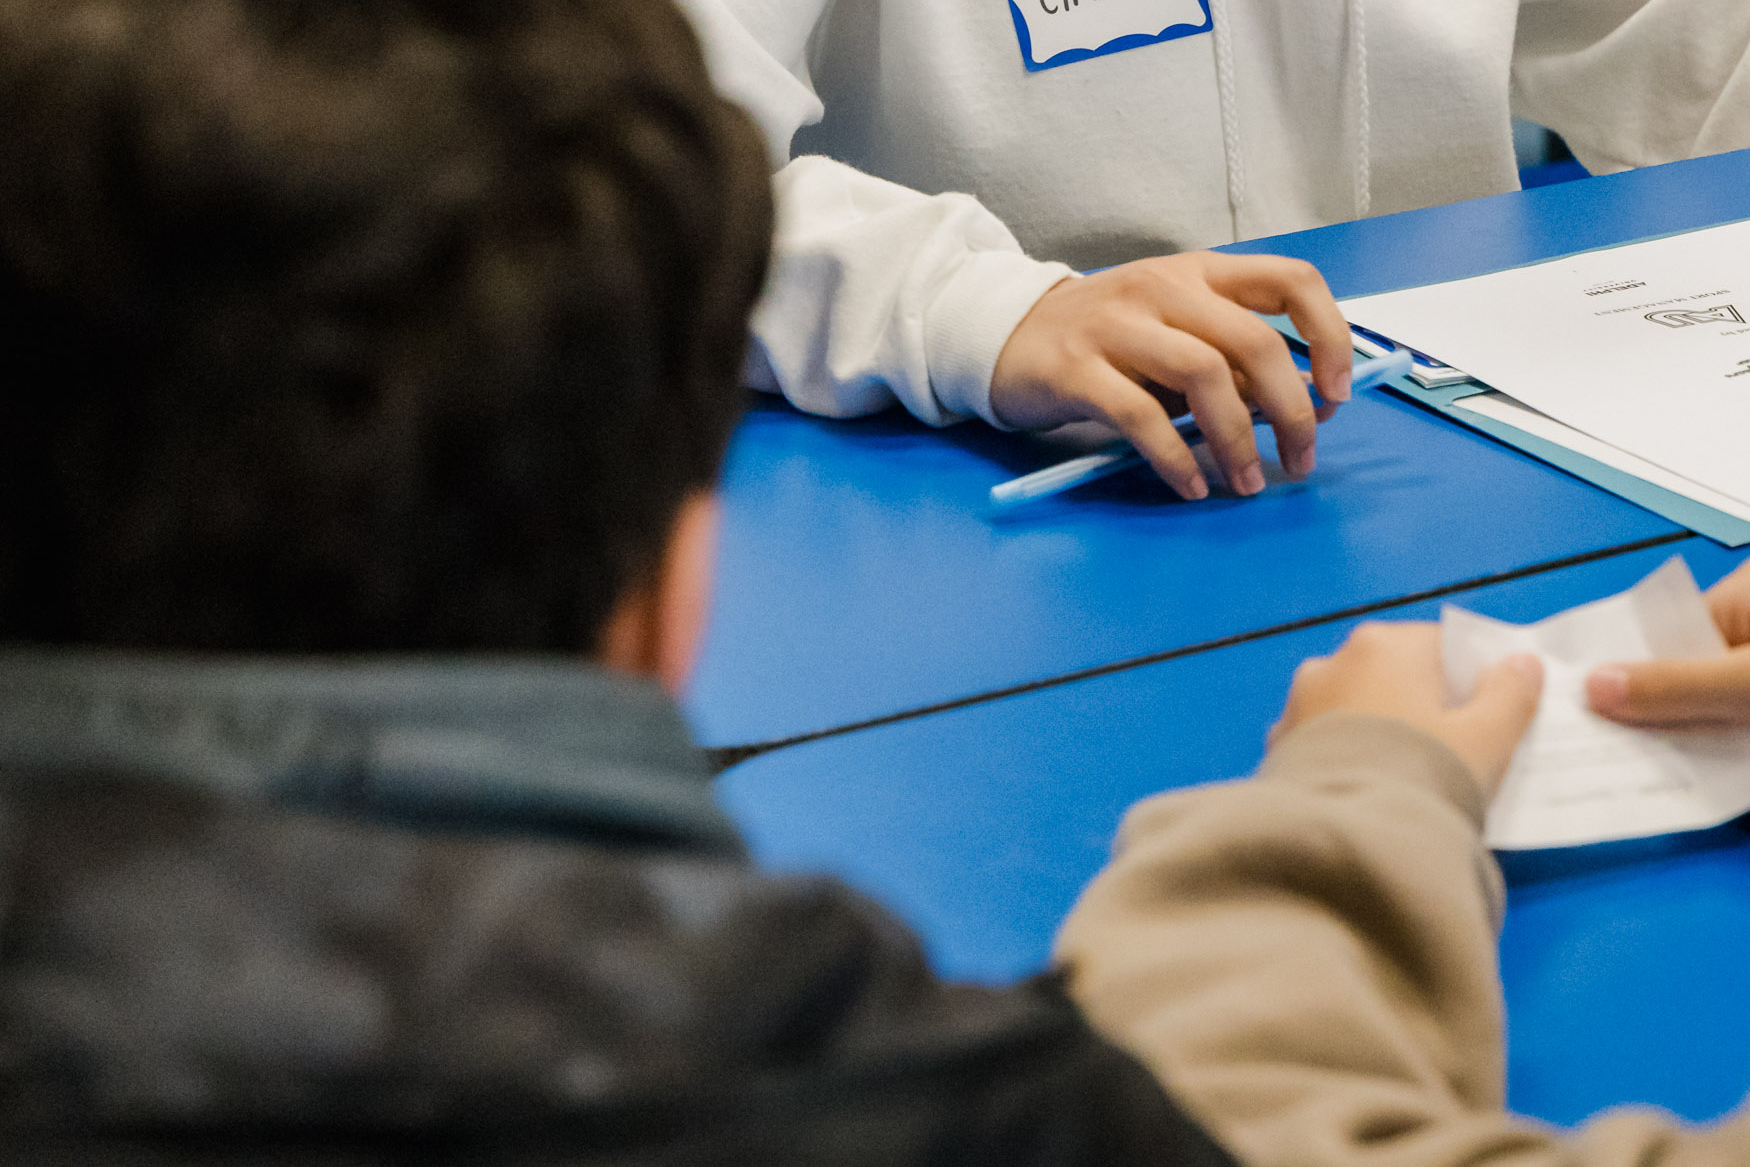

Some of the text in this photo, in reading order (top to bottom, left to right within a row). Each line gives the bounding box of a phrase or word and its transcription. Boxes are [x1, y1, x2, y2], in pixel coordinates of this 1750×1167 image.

[1584, 281, 1647, 297] ADELPHI
[1593, 289, 1732, 317] SPORT MANAGEMENT
[1643, 304, 1747, 329] AU
